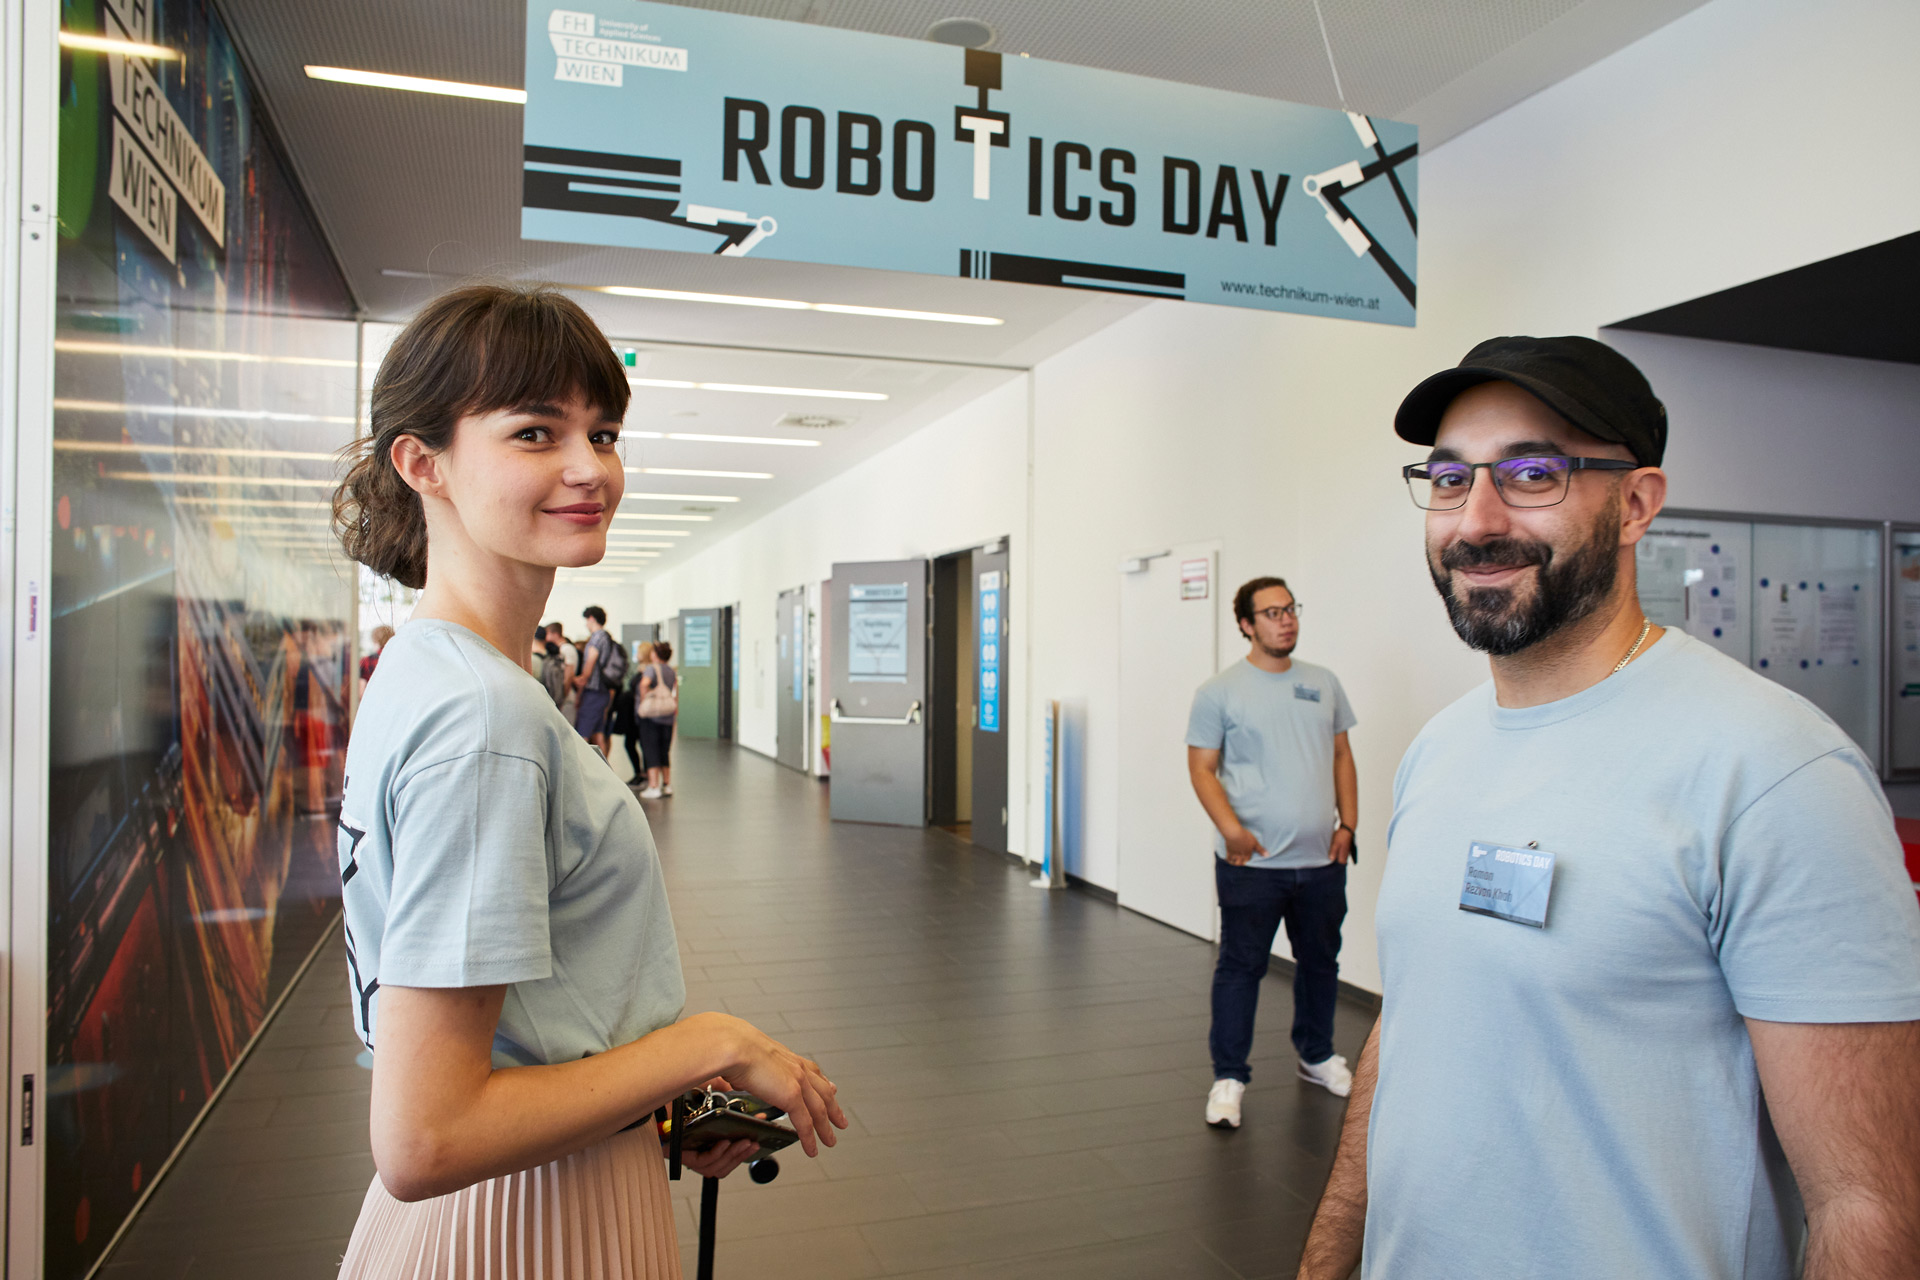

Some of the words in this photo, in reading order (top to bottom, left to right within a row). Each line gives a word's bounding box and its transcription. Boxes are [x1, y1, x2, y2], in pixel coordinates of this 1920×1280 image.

[562, 15, 588, 33] FH
[598, 19, 638, 32] University
[639, 24, 649, 32] of
[598, 27, 629, 39] Applied
[629, 30, 662, 42] Sciences
[562, 38, 681, 67] TECHNIKUM
[563, 61, 616, 82] WIEN
[119, 51, 220, 235] TECHNIKUM
[722, 97, 1136, 227] ROBOTICS
[1163, 156, 1291, 247] DAY
[119, 137, 172, 245] WIEN
[1221, 281, 1380, 310] www.technikum-wien.at
[1495, 850, 1532, 867] ROBOTICS
[1533, 855, 1552, 869] DAY
